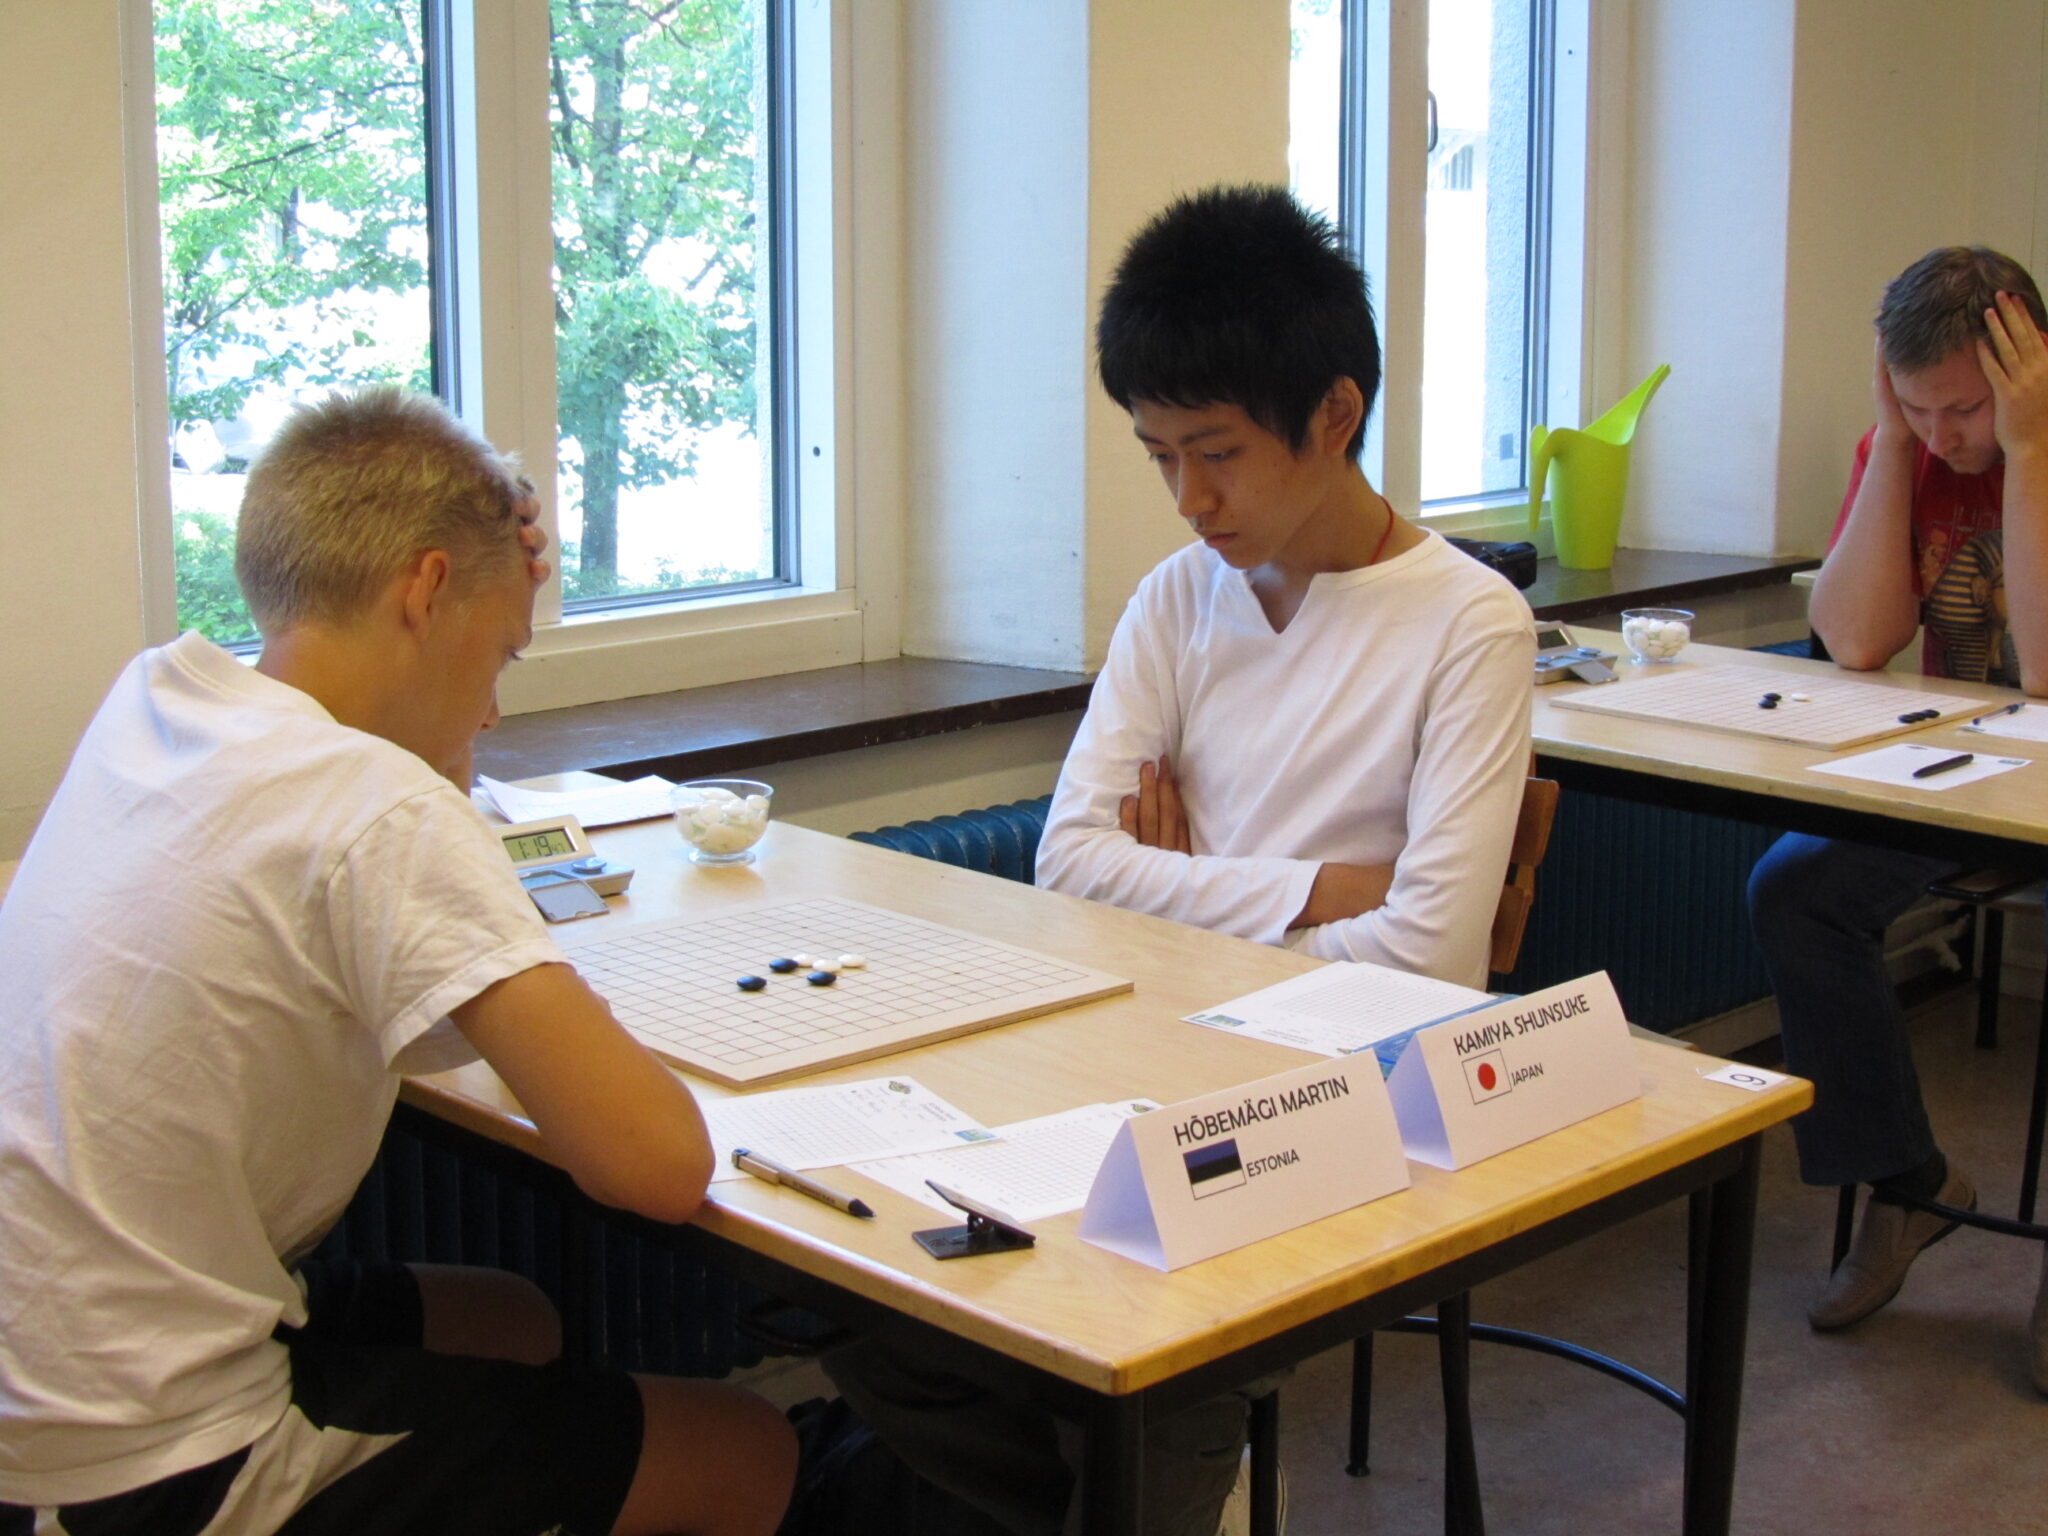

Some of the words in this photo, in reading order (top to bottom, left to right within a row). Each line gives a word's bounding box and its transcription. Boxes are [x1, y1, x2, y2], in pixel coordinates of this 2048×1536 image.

[1453, 1020, 1514, 1056] KAMIYA
[1514, 994, 1590, 1035] SHUNSUKE
[1511, 1063, 1544, 1086] JAPAN
[1173, 1097, 1278, 1146] HÕBEMÄGI
[1279, 1075, 1350, 1114] MARTIN
[1246, 1149, 1300, 1177] ESTONIA
